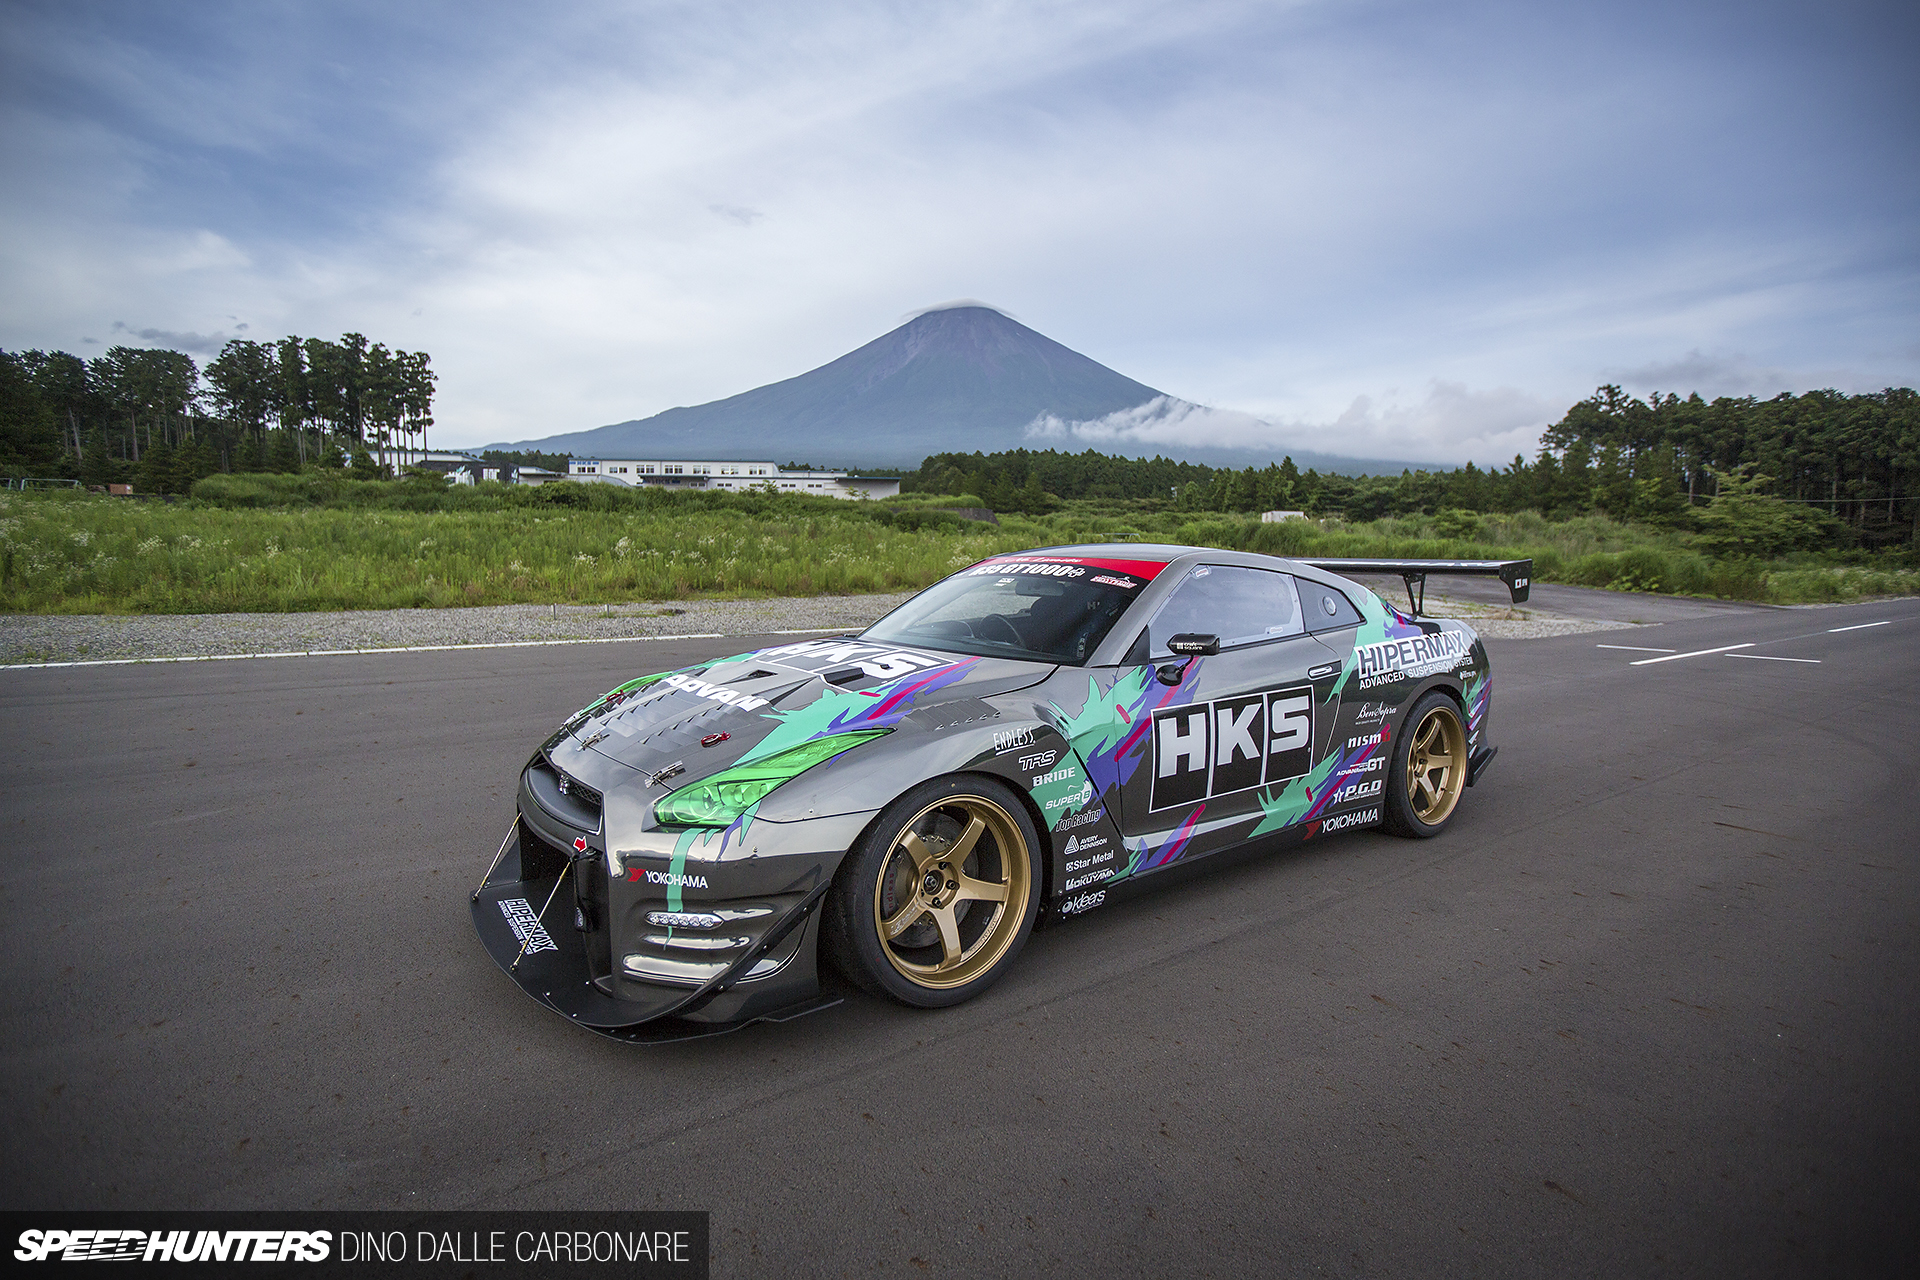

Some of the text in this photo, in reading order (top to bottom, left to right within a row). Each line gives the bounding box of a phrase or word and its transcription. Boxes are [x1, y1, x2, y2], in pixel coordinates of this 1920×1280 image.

[765, 640, 942, 679] HKS
[1354, 630, 1471, 680] HIPERMAX
[1359, 671, 1405, 691] ADVANCED
[1407, 659, 1454, 678] SUSPENSION
[661, 673, 770, 713] ADVAN
[992, 726, 1035, 751] ENDLESS
[1158, 695, 1310, 779] HKS
[1347, 732, 1391, 748] nismo
[1018, 749, 1057, 772] TRS
[1032, 766, 1076, 787] BRIDE
[1045, 792, 1081, 810] SUPER
[1071, 808, 1102, 829] Racing
[1322, 811, 1379, 834] YOKOHAMA
[1080, 834, 1099, 846] AVERY
[1080, 838, 1108, 851] DENNISON
[1073, 849, 1115, 871] Star Metal
[645, 870, 709, 889] YOKOHAMA
